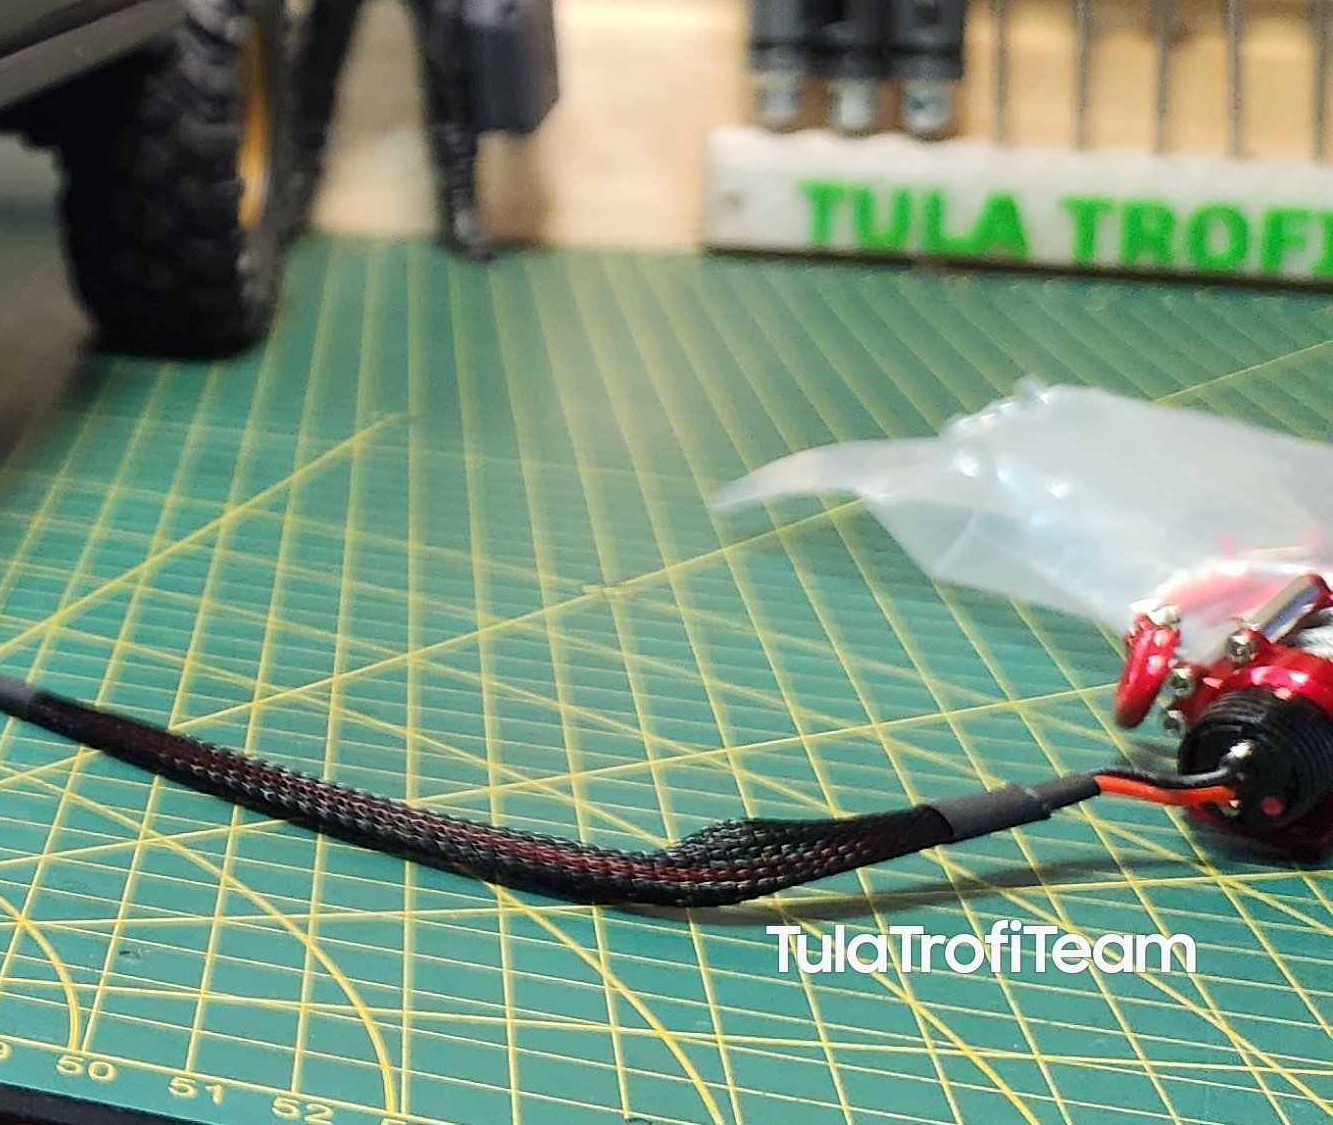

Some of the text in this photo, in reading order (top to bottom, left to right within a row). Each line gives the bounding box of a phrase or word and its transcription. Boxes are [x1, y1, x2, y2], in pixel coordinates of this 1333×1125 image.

[800, 181, 1028, 258] TULA
[55, 1053, 118, 1082] 50
[168, 1076, 225, 1105] 51
[271, 1096, 335, 1125] 52
